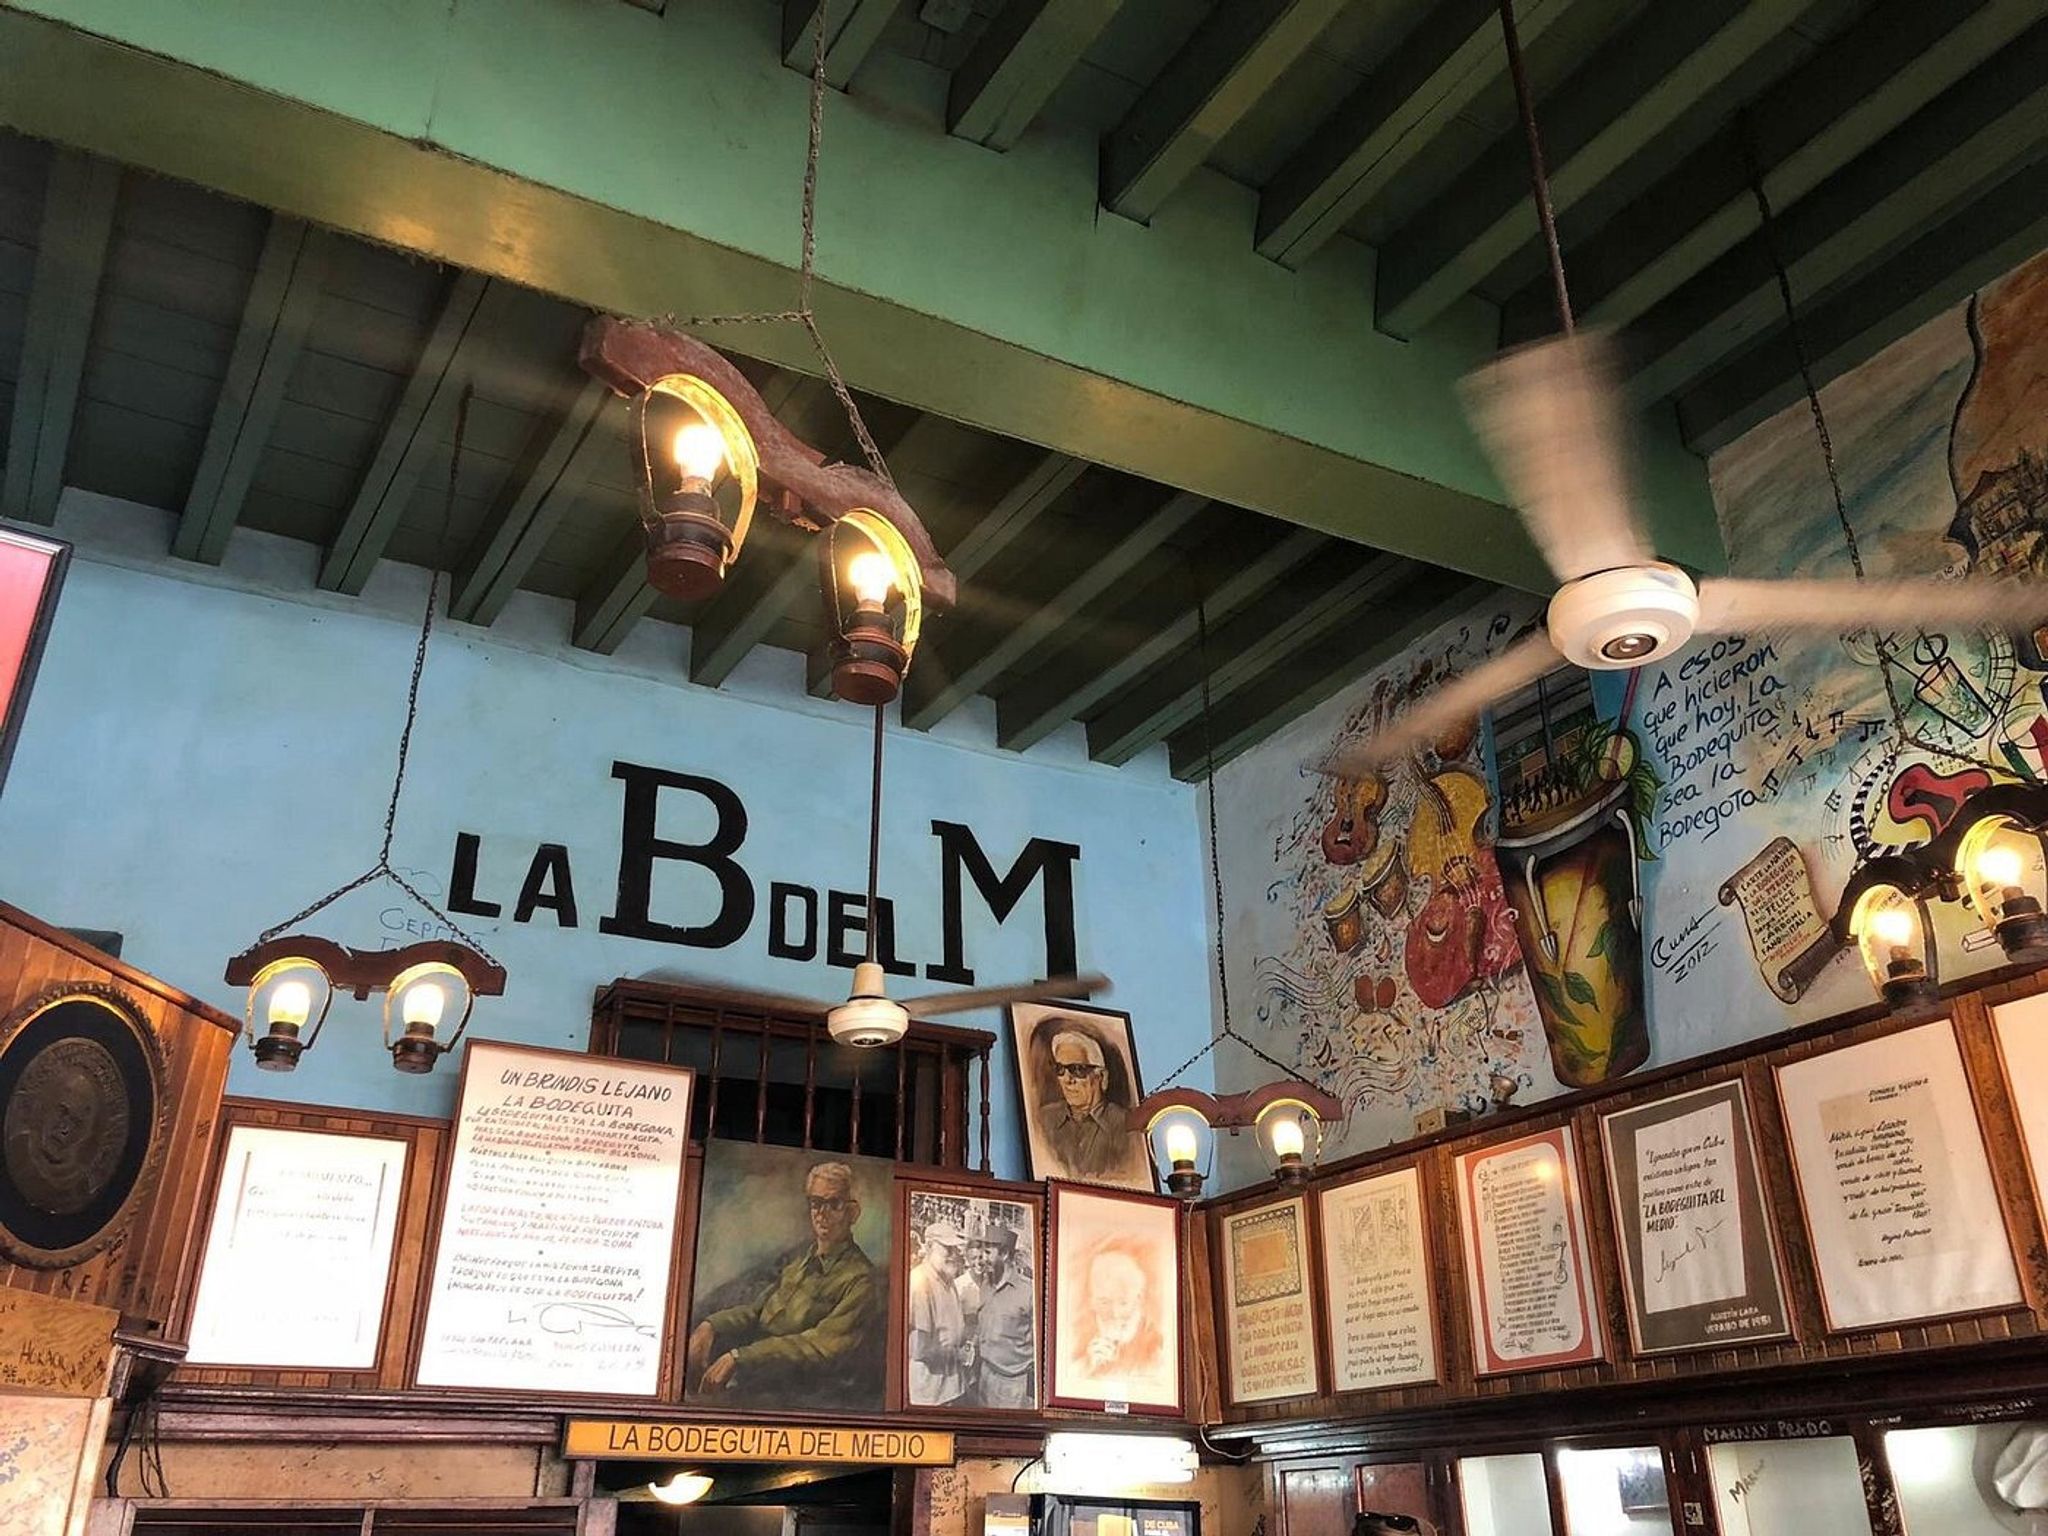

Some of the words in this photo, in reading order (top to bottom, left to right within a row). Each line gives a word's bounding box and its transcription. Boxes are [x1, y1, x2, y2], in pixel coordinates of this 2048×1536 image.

[1653, 670, 1673, 701] A
[1679, 634, 1747, 682] esos
[1643, 700, 1677, 739] que
[1655, 724, 1688, 764] que
[1662, 784, 1703, 814] sea
[447, 831, 578, 928] LA
[600, 760, 755, 949] B
[768, 881, 916, 977] DEL
[926, 819, 1090, 1000] M
[500, 1067, 521, 1087] UN
[522, 1071, 600, 1094] BRINDIS
[600, 1080, 673, 1102] LEJANO
[502, 1095, 524, 1108] LA
[529, 1096, 634, 1119] BODEGUITA
[590, 1118, 605, 1128] LA
[608, 1424, 640, 1452] LA
[648, 1426, 792, 1456] BODEGUITA
[799, 1431, 843, 1458] DEL
[850, 1433, 926, 1459] MEDIO
